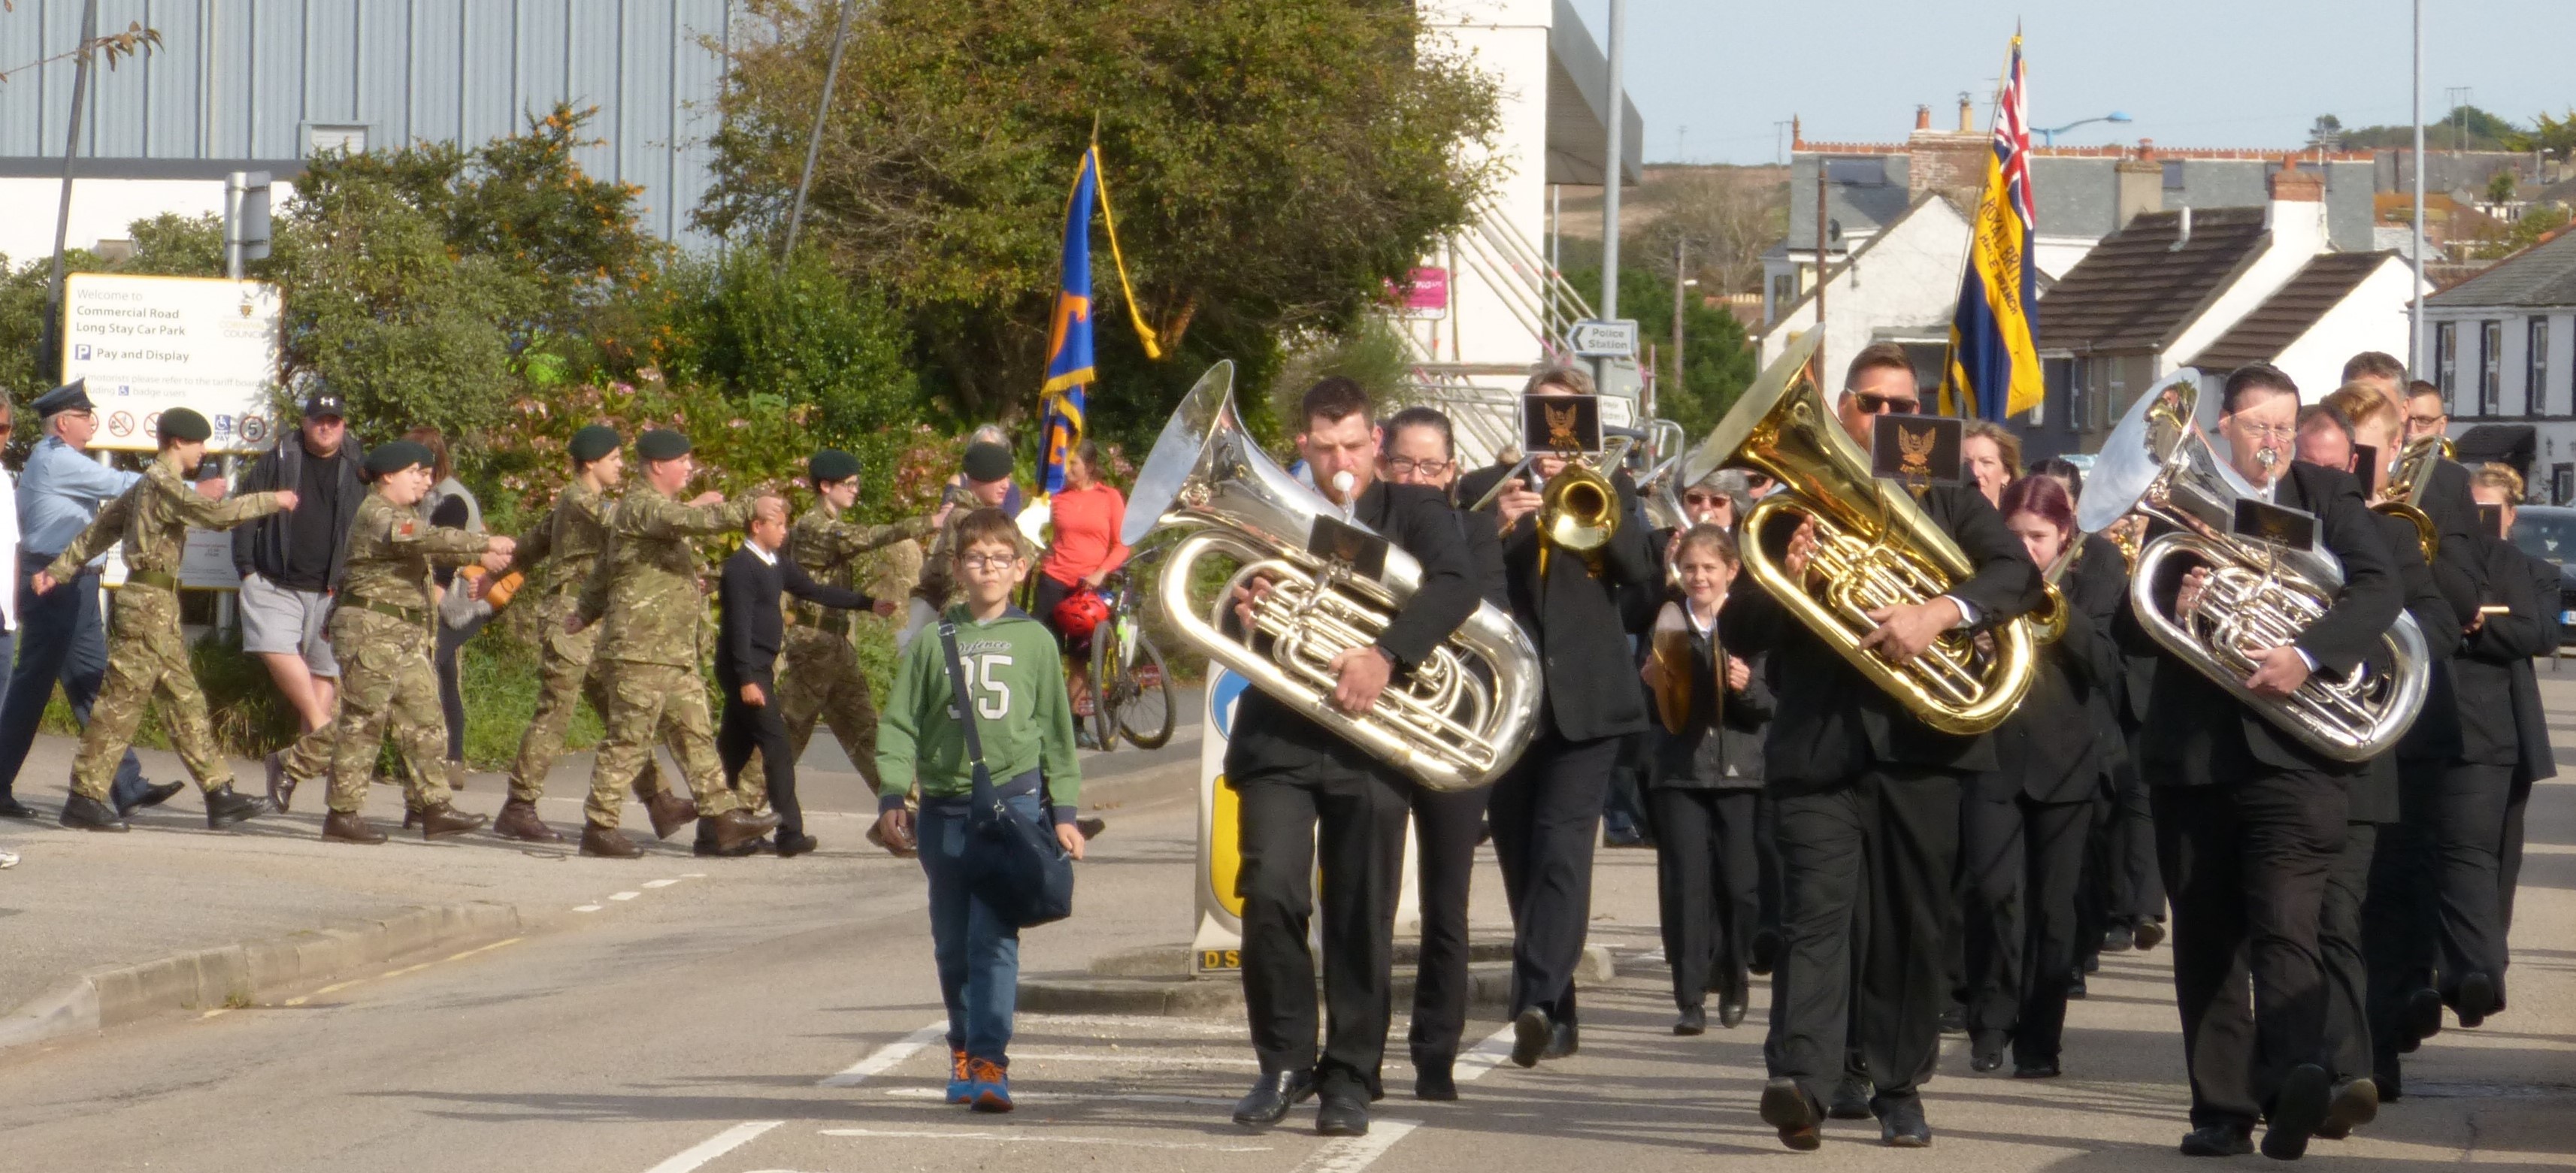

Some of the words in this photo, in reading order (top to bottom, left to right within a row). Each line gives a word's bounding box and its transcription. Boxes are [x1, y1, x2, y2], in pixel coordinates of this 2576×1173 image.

[77, 289, 129, 301] Welcome
[132, 292, 143, 301] to
[1993, 271, 2018, 316] BRANCH
[77, 305, 147, 318] Commercial
[150, 308, 180, 319] Road
[76, 322, 105, 335] Long
[109, 323, 134, 336] Stay
[137, 325, 157, 335] Car
[159, 325, 186, 336] Park
[1592, 328, 1625, 337] Police
[1588, 339, 1627, 349] Station
[97, 348, 118, 361] Pay
[121, 349, 143, 359] and
[146, 350, 189, 363] Display
[88, 374, 129, 382] motorists
[132, 375, 160, 385] please
[162, 376, 182, 384] refer
[195, 377, 210, 385] the
[212, 378, 233, 386] tariff
[133, 388, 161, 397] badge
[247, 423, 257, 436] 5
